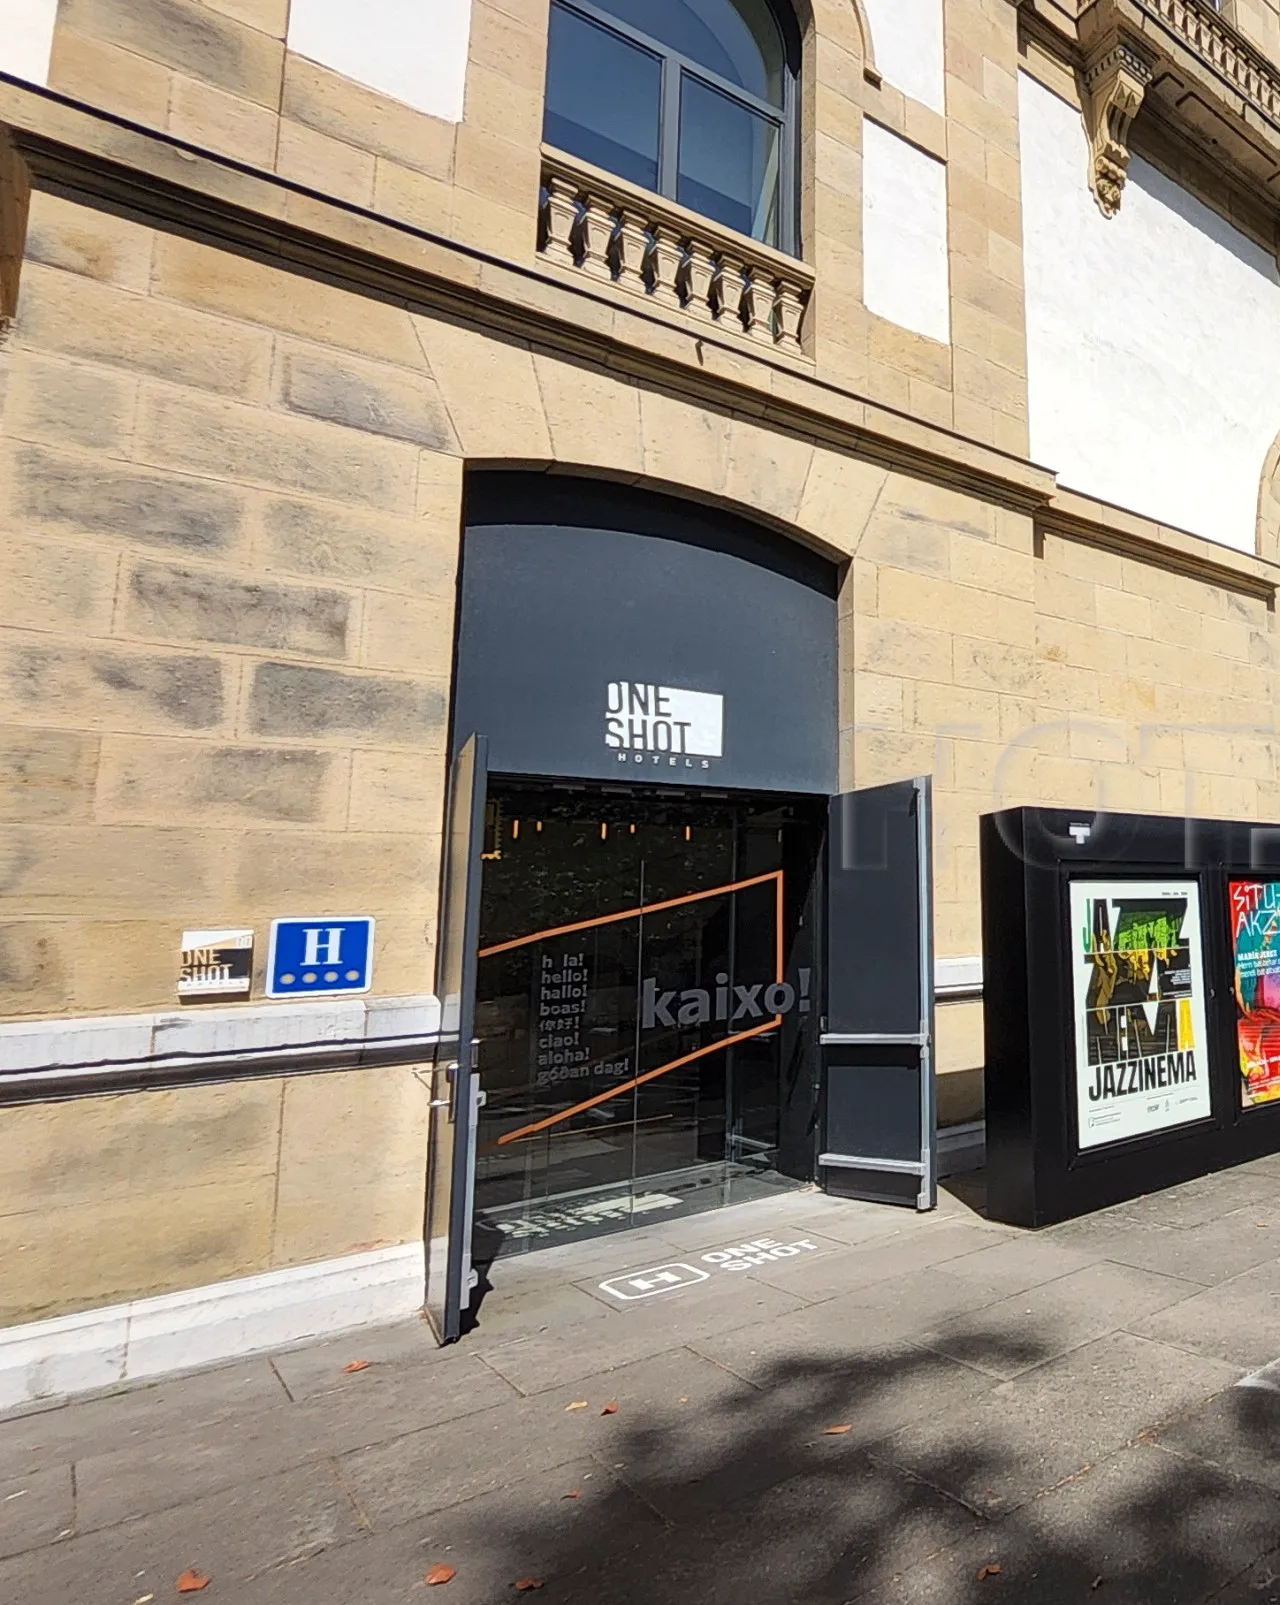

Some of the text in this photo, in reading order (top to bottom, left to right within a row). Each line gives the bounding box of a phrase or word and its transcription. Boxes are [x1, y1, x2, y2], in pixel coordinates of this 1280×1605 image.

[605, 681, 673, 718] ONE
[605, 716, 692, 755] SHOT
[617, 752, 711, 769] HOTELS
[299, 927, 347, 967] H
[542, 953, 584, 968] hla!
[178, 963, 235, 982] SHOT
[541, 968, 588, 984] hello!
[540, 984, 588, 1000] hallo!
[641, 967, 812, 1030] kaixo!
[540, 1000, 586, 1016] boas!
[539, 1031, 580, 1048] ciao!
[538, 1047, 590, 1065] aloha!
[593, 1058, 629, 1076] dag!
[1088, 1050, 1197, 1102] JAZZINEMA
[701, 1238, 784, 1263] ONE
[720, 1239, 818, 1271] SHOT
